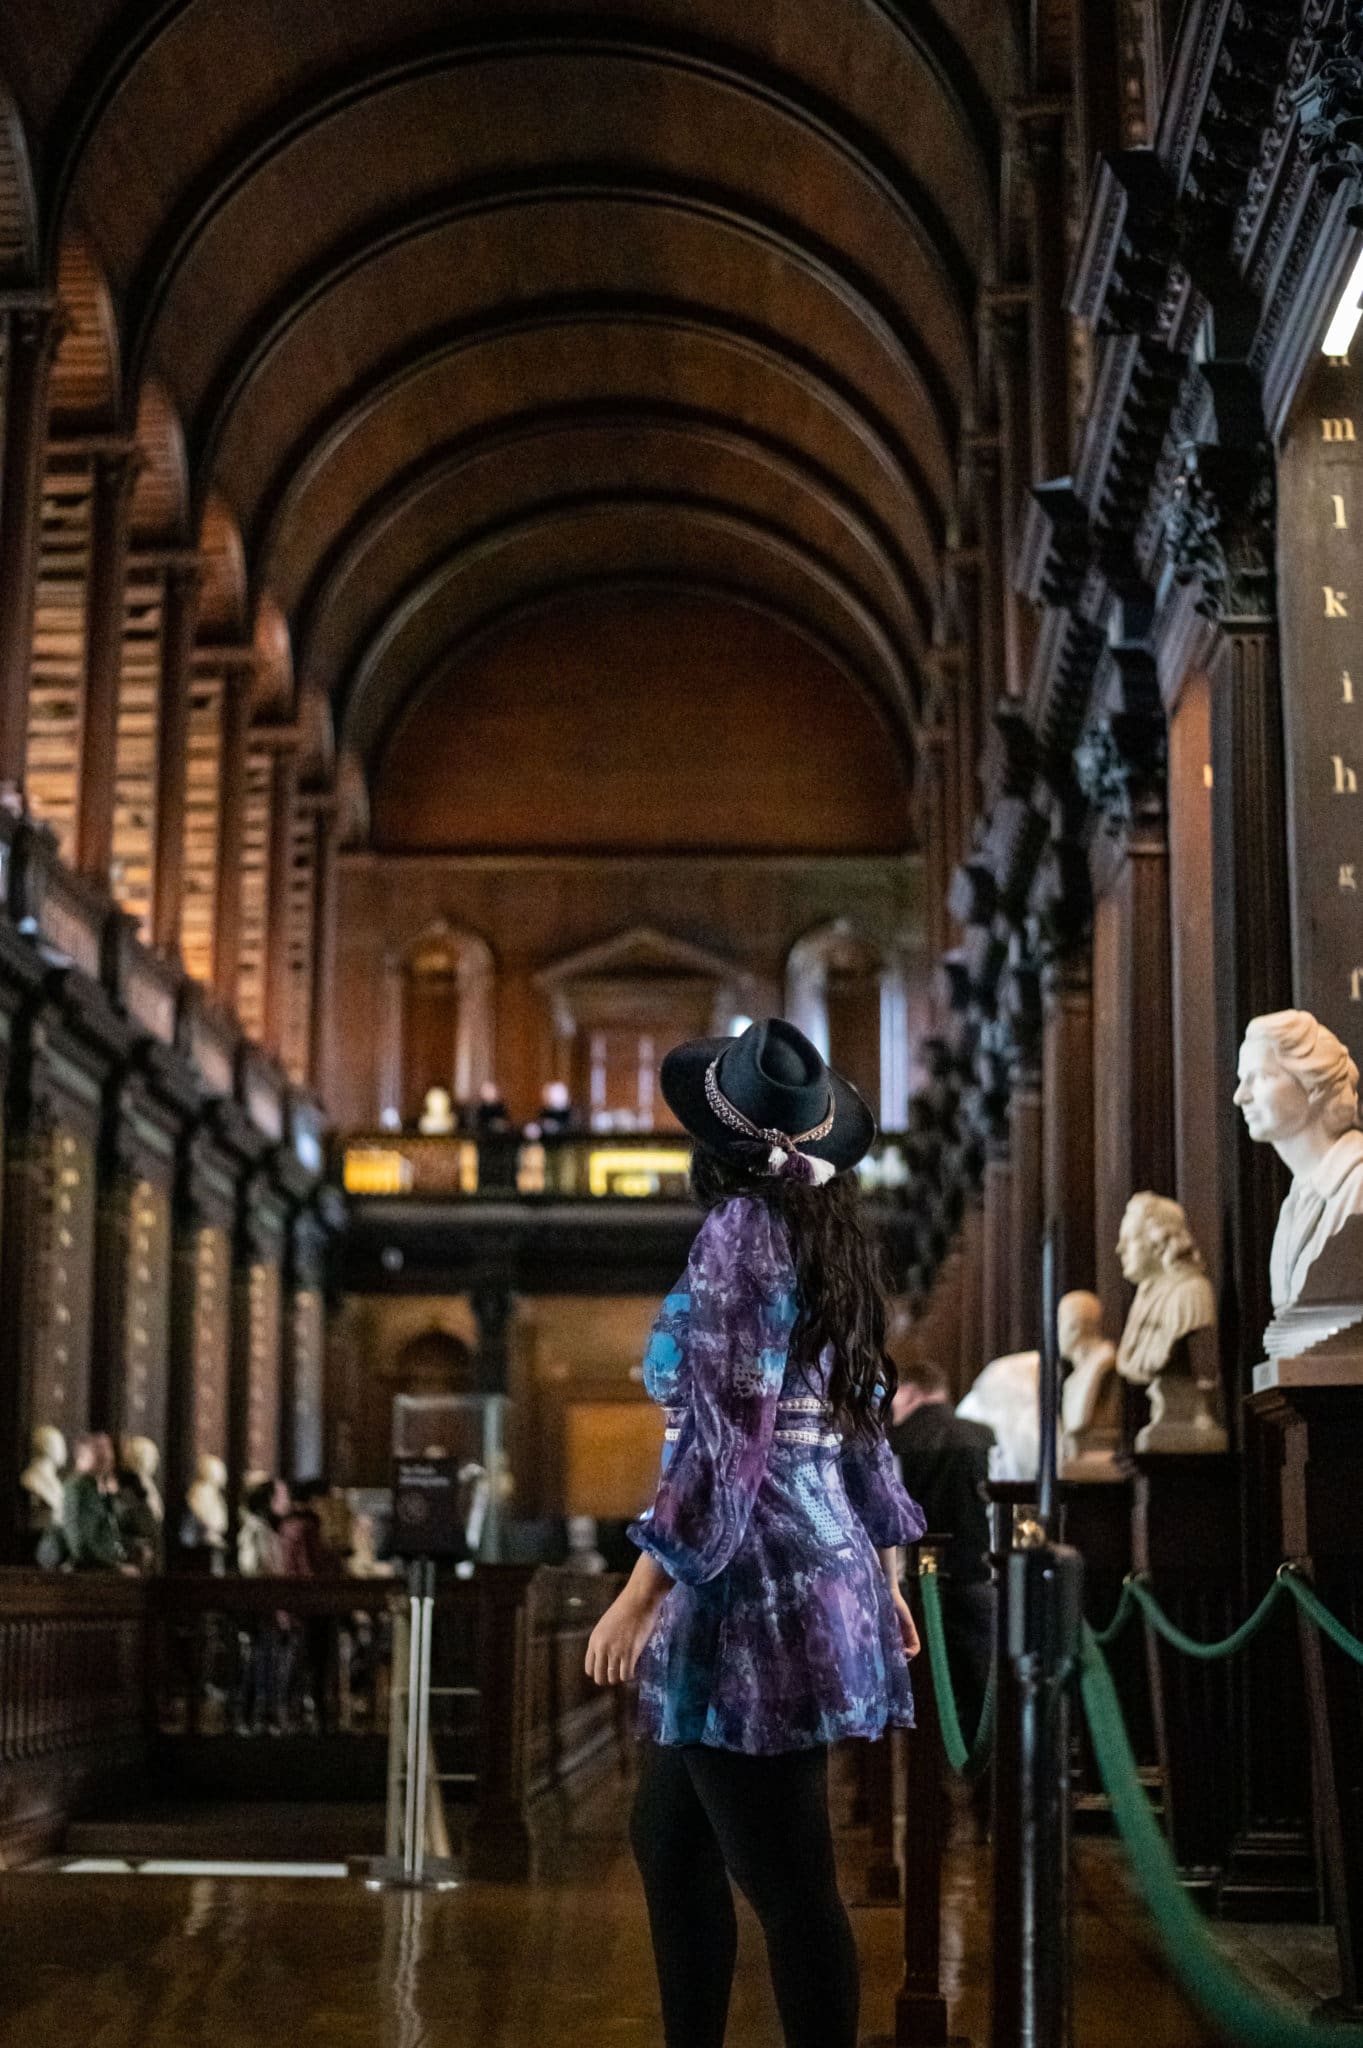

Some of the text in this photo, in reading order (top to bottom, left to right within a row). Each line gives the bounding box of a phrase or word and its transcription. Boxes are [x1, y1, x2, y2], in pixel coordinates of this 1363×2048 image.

[1321, 417, 1356, 442] m
[1322, 586, 1348, 618] k
[1342, 670, 1353, 704] i
[1331, 755, 1357, 793] h
